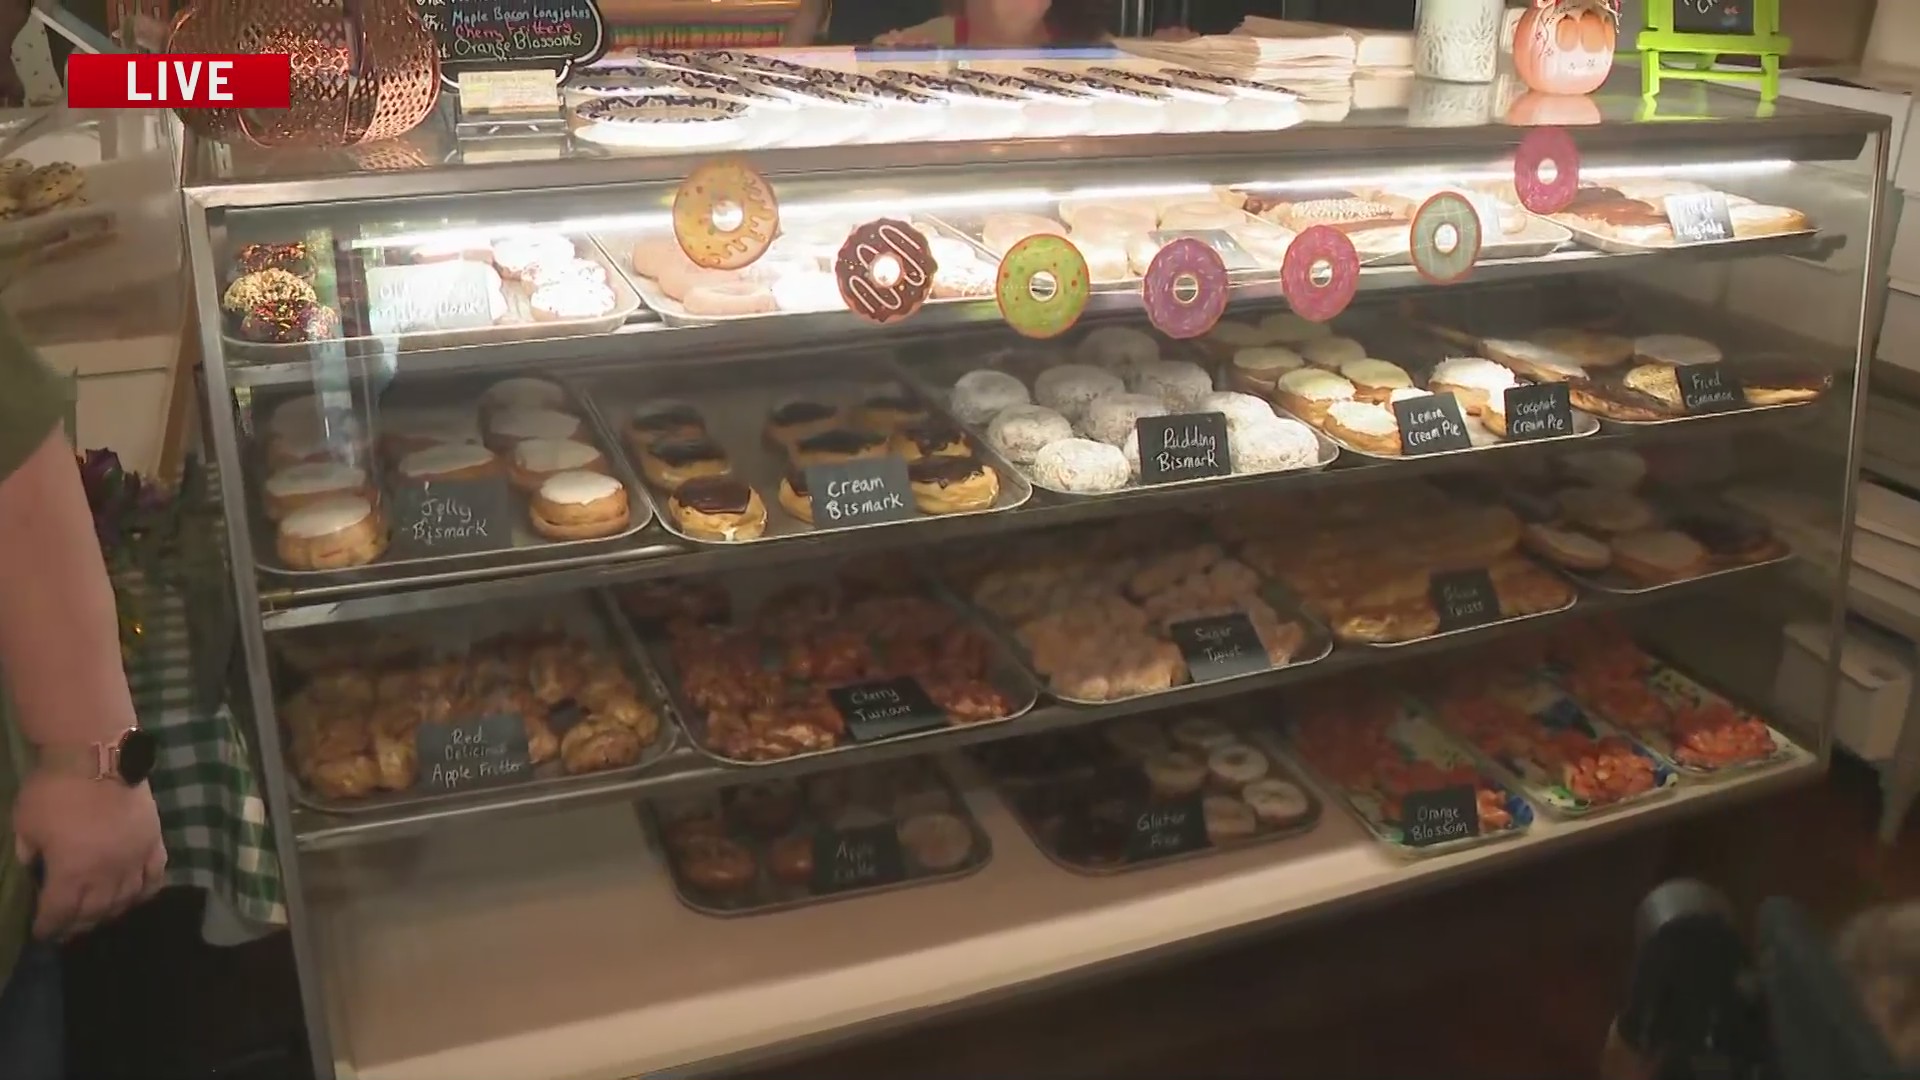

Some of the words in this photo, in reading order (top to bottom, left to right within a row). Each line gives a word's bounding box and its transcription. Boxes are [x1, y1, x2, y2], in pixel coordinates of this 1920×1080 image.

[452, 9, 489, 28] Maple
[494, 6, 530, 21] Bacon
[455, 23, 505, 42] Cherry
[454, 37, 511, 60] Orange
[513, 32, 583, 50] Blossoms
[1410, 407, 1446, 425] Lemon
[1513, 418, 1546, 435] Cream
[1547, 413, 1565, 431] Pie
[1163, 425, 1216, 453] Pudding
[1407, 428, 1441, 446] Cream
[1441, 419, 1462, 437] Pie
[827, 477, 885, 498] Cream
[421, 498, 472, 523] Jelly
[825, 492, 904, 520] Bismark
[451, 725, 483, 745] Red
[431, 763, 473, 789] Apple
[1417, 806, 1460, 825] Orange
[1410, 821, 1469, 841] Blossom
